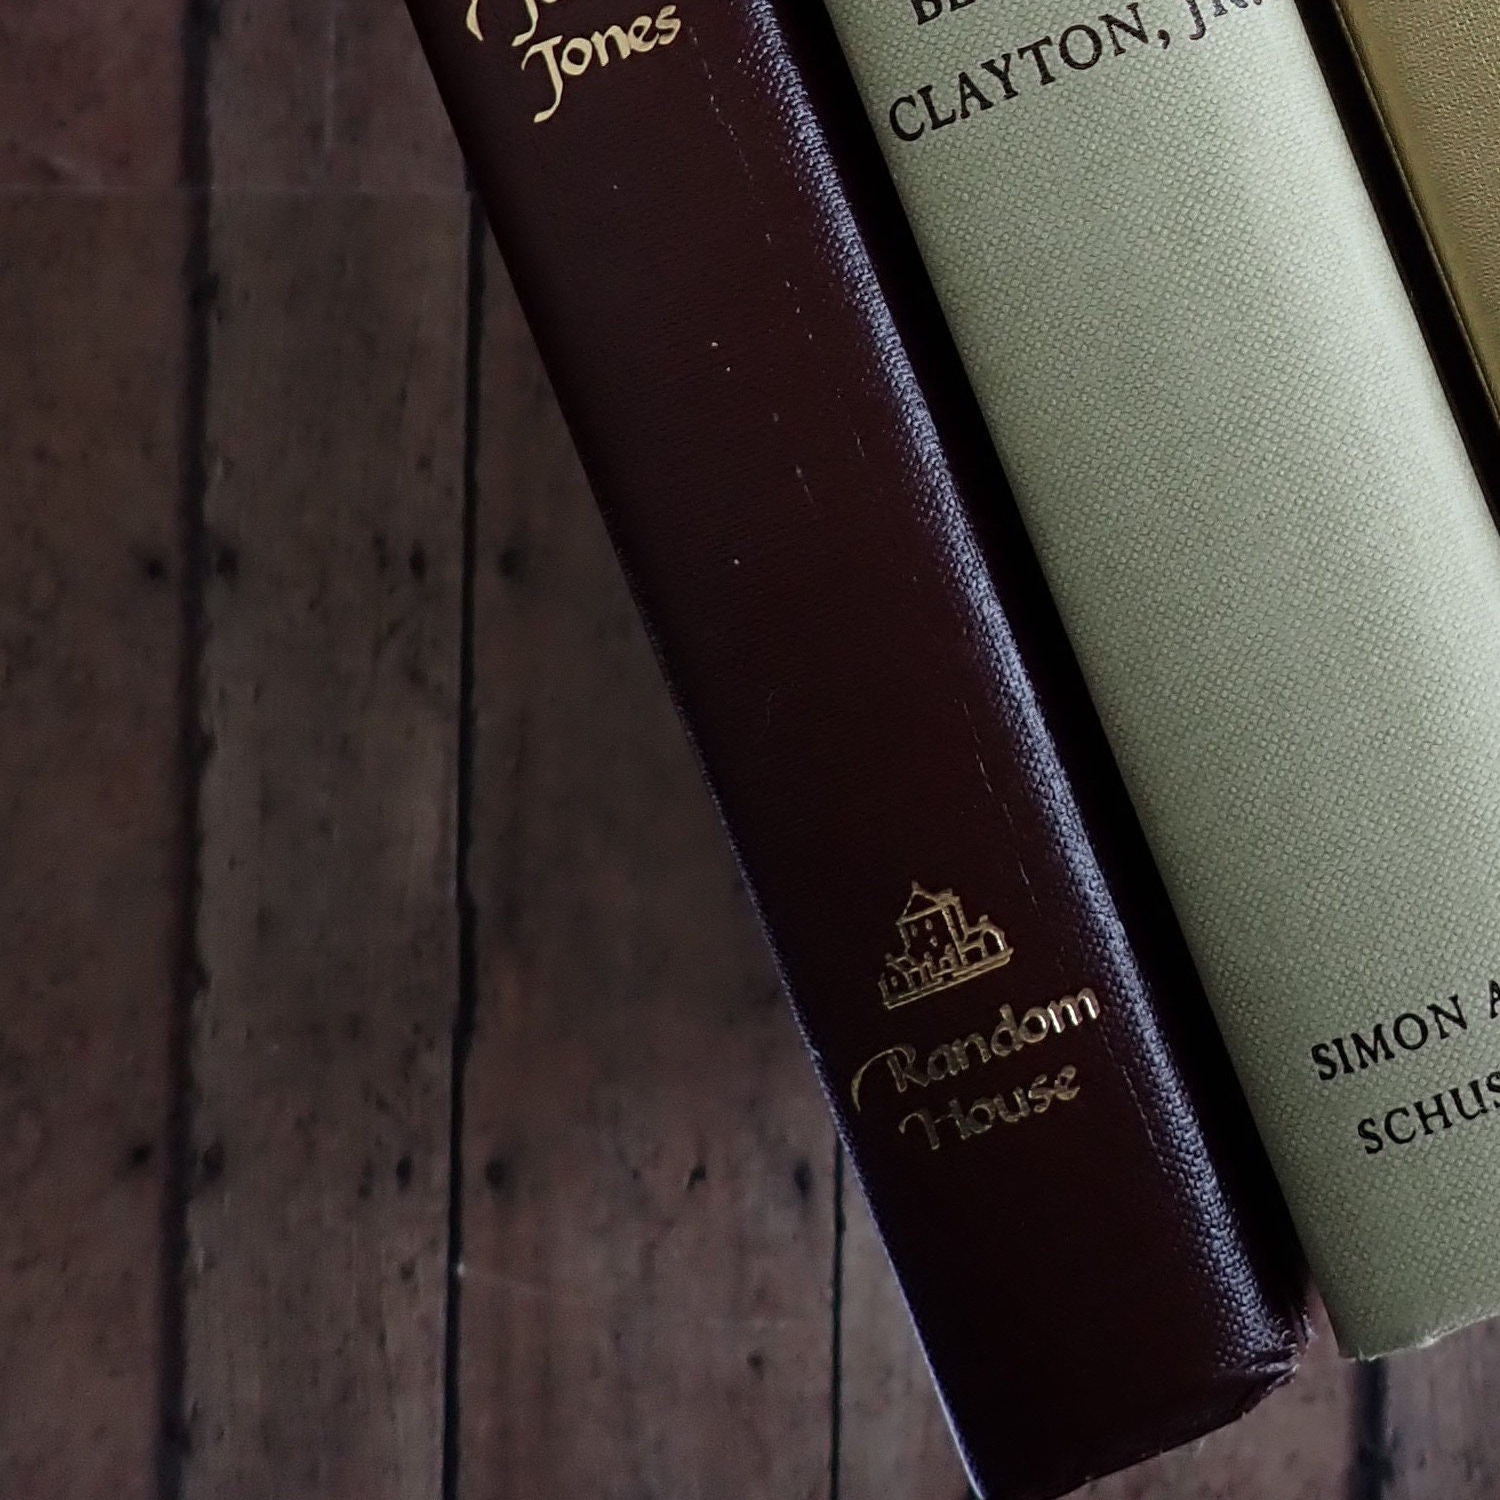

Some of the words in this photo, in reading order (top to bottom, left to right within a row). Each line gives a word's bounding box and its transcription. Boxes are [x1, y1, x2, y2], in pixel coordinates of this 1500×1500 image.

[521, 4, 681, 123] Jones
[889, 2, 1171, 142] CLAYTON,
[851, 987, 1100, 1112] Random
[1311, 994, 1467, 1081] SIMON
[899, 1064, 1080, 1150] House
